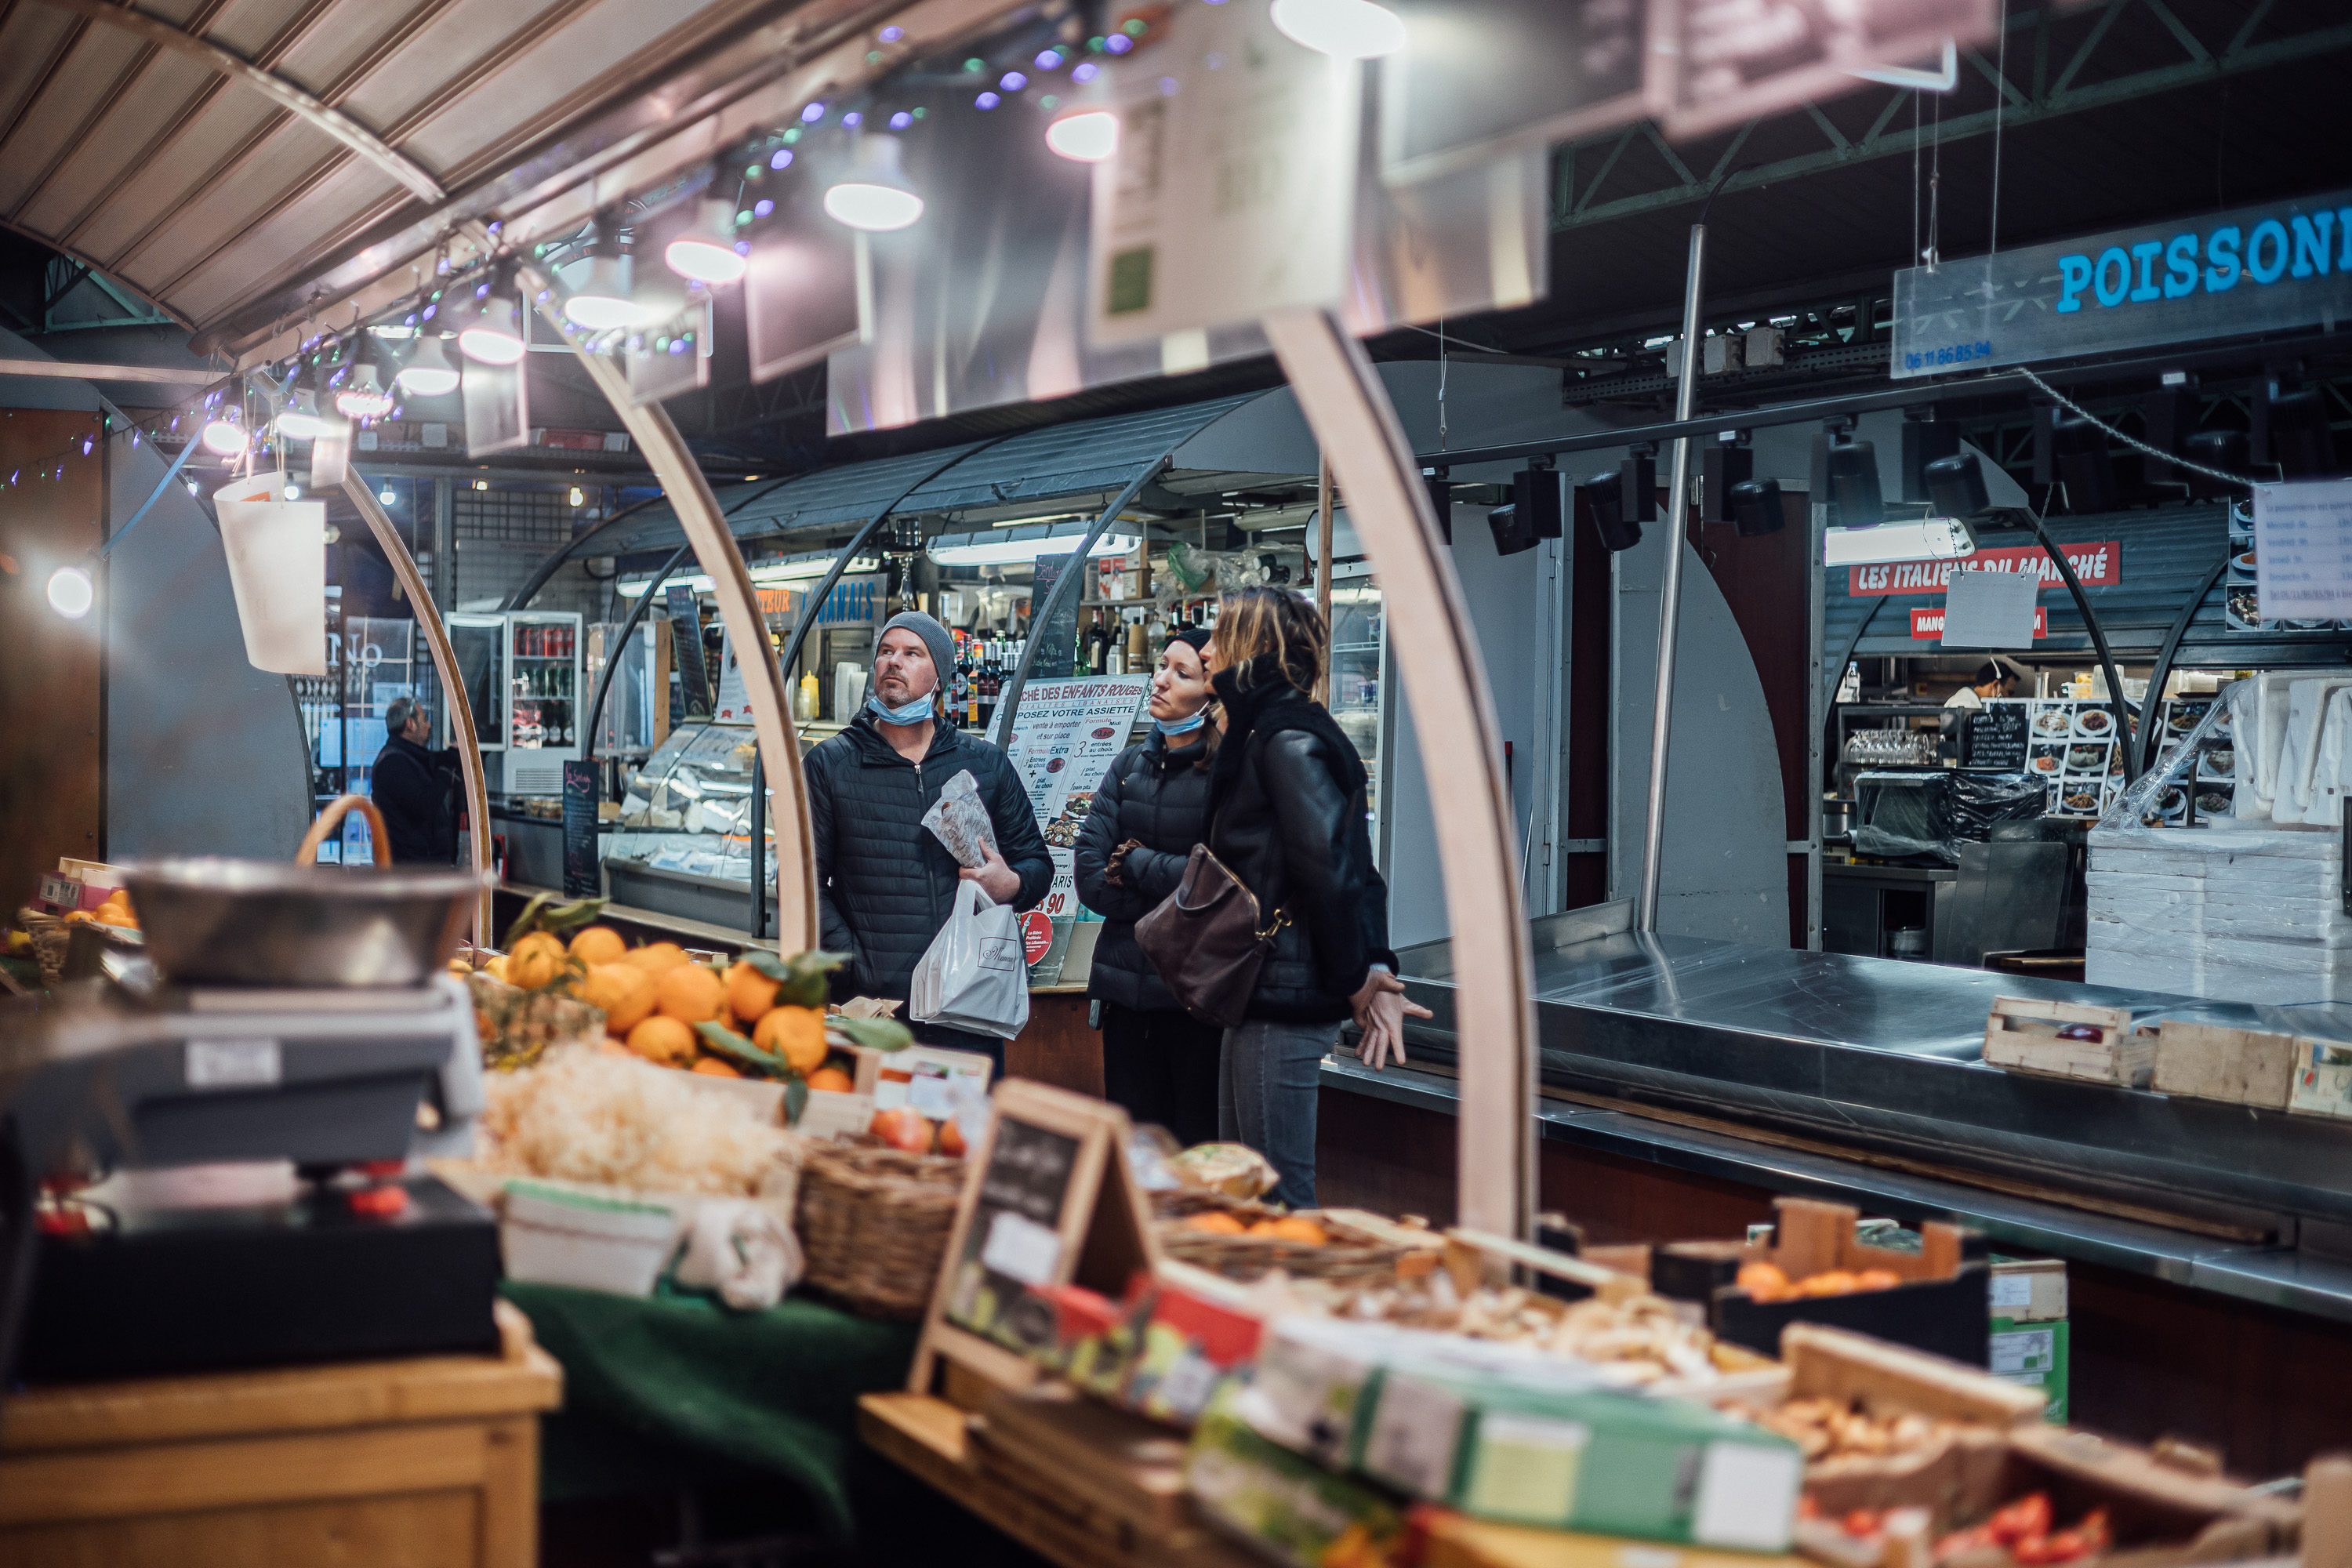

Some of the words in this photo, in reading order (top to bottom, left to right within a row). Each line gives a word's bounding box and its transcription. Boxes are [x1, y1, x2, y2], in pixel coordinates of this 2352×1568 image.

[1905, 351, 1922, 370] 06
[1925, 350, 1935, 366] 11
[1937, 347, 1954, 365] 86
[1955, 344, 1973, 361] 85
[1858, 565, 1889, 590] LES
[1041, 687, 1061, 701] DES
[1062, 684, 1108, 699] ENFANTS
[1105, 684, 1143, 697] ROUGES
[1073, 699, 1134, 707] LIBANAISES
[1086, 706, 1135, 715] ASSIETTE
[1054, 720, 1081, 730] emporter
[1054, 731, 1070, 741] place
[1074, 741, 1087, 758] 3
[1052, 875, 1073, 888] ARIS
[983, 946, 1014, 963] Manon
